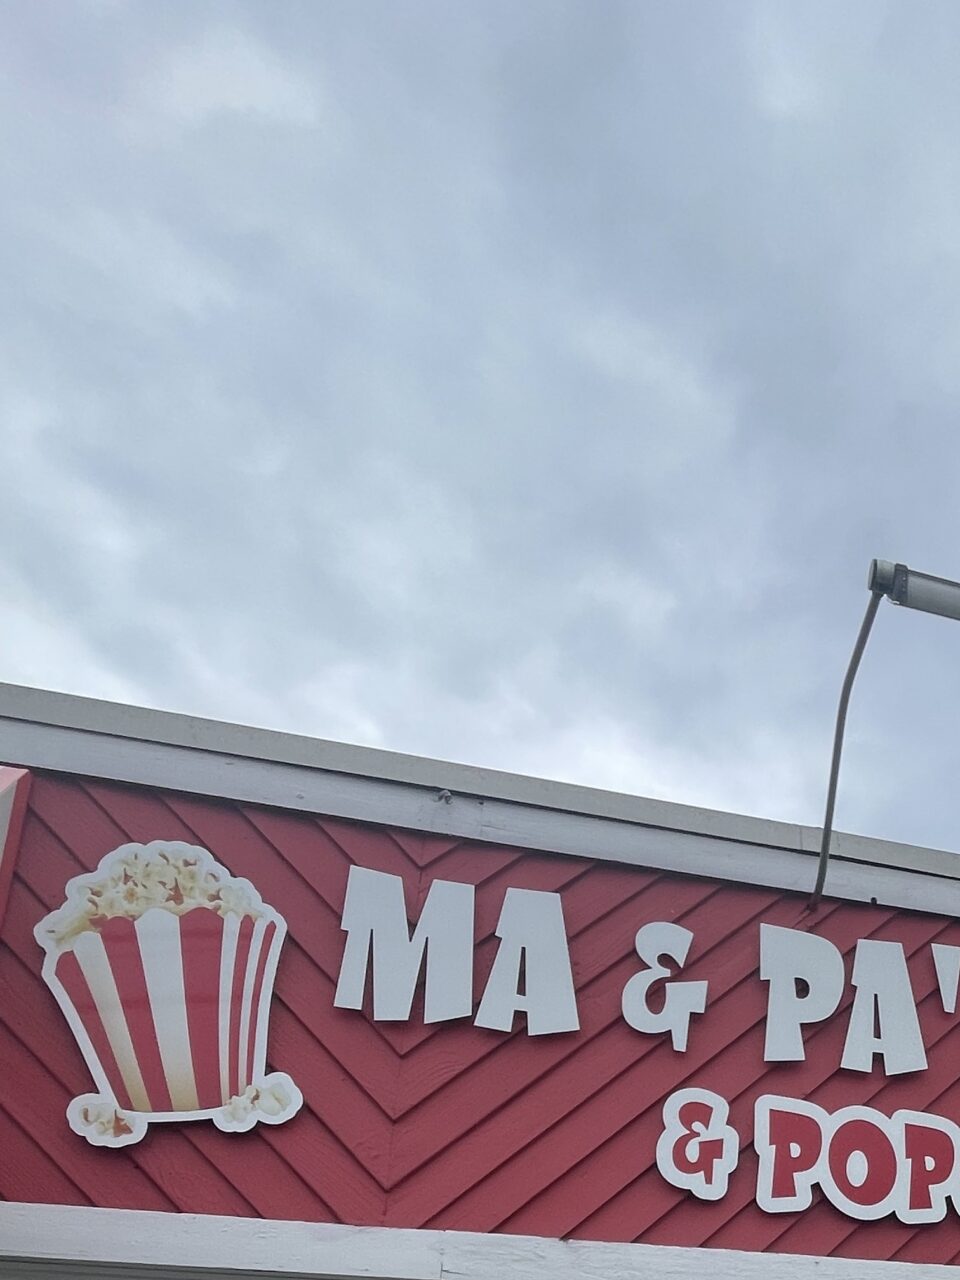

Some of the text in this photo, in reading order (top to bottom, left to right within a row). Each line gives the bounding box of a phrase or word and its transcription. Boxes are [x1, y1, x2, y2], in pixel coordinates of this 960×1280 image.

[333, 864, 580, 1037] MA
[621, 920, 709, 1053] &
[670, 1099, 726, 1187] &
